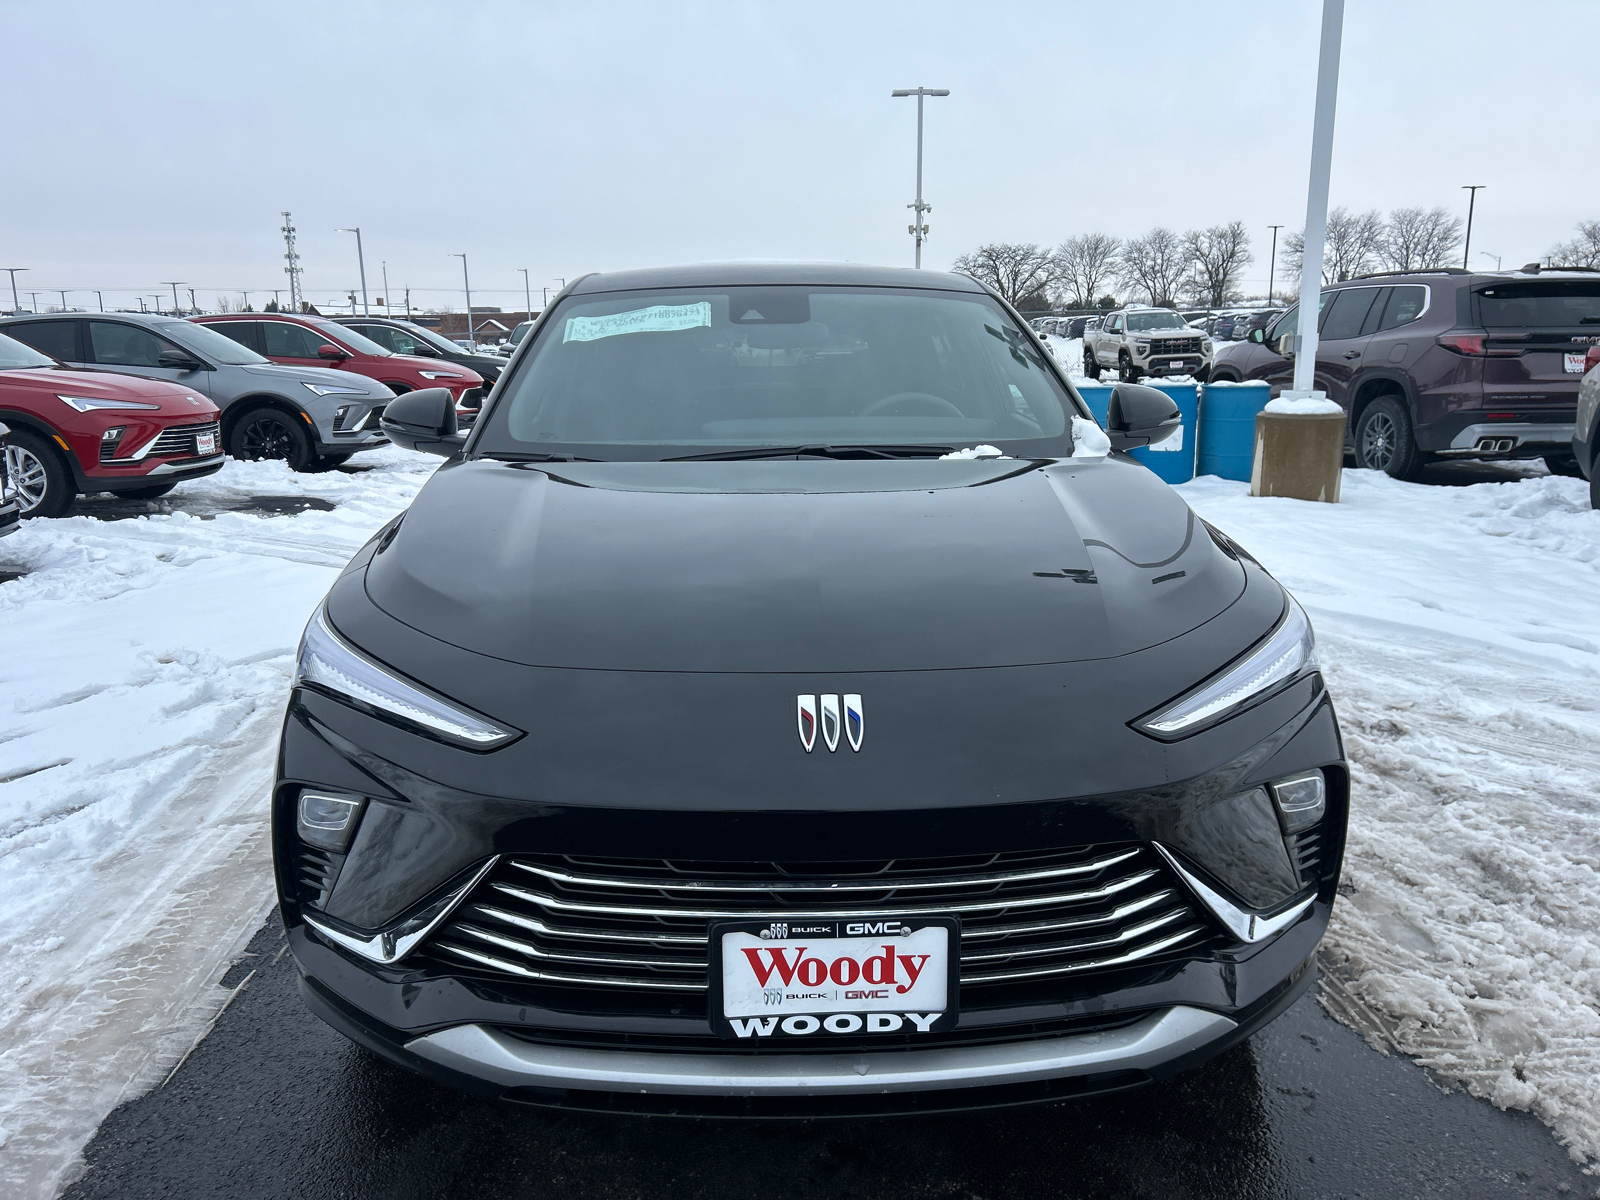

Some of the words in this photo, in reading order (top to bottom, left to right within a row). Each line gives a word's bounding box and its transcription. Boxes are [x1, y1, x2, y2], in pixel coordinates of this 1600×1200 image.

[791, 926, 832, 934] BUICK
[845, 921, 902, 935] GMC
[740, 945, 931, 994] Woody
[785, 992, 828, 1000] BUICK
[844, 989, 889, 1000] GMC
[728, 1013, 943, 1038] WOODY
